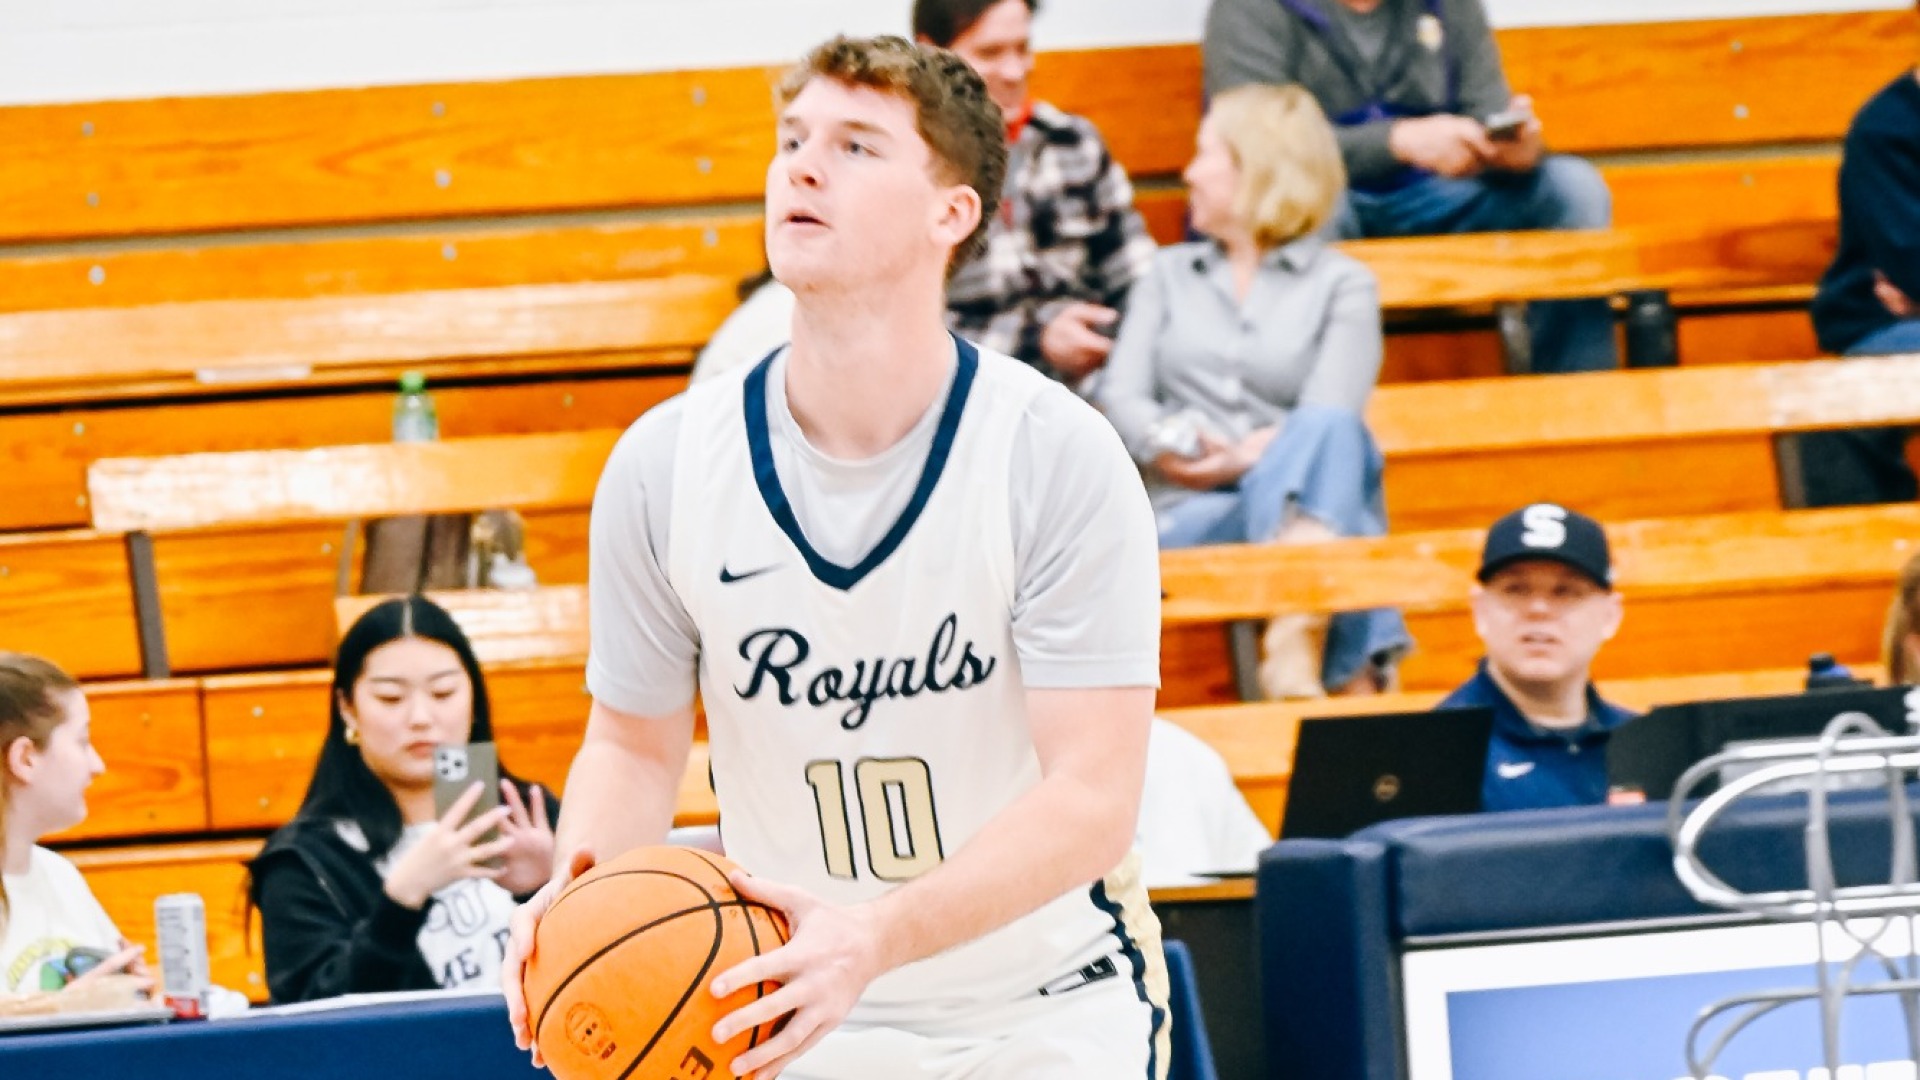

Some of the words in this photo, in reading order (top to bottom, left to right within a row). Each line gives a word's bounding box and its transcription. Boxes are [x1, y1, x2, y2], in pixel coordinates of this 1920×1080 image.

[1521, 503, 1567, 549] S
[733, 612, 996, 731] Royals
[804, 756, 944, 883] 10
